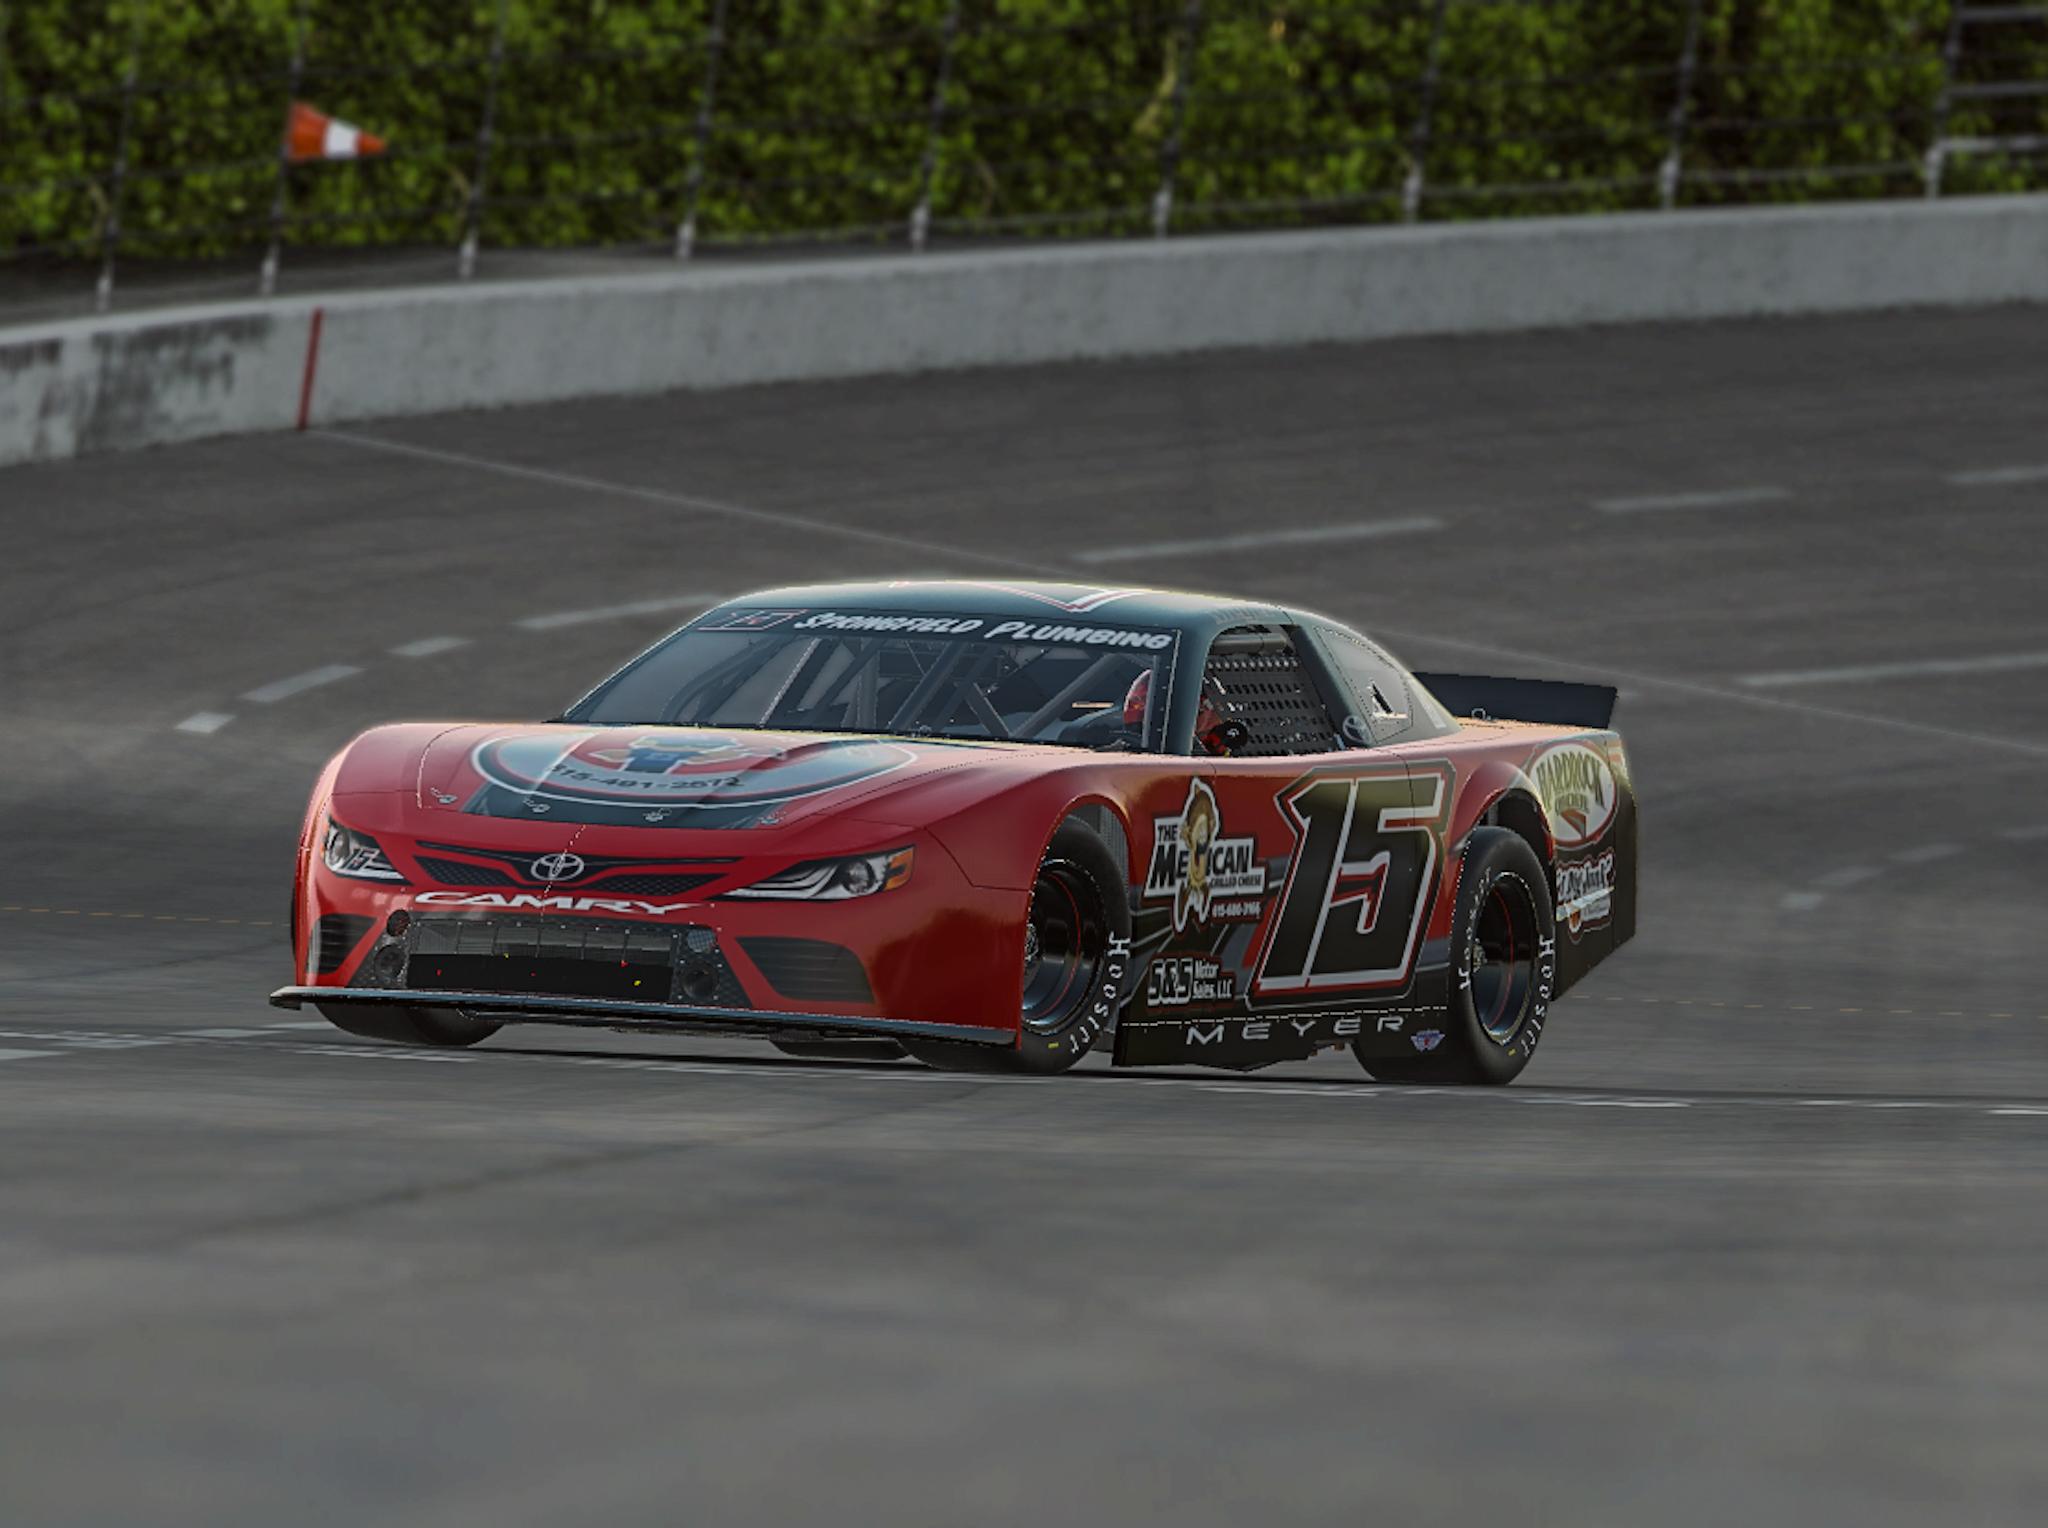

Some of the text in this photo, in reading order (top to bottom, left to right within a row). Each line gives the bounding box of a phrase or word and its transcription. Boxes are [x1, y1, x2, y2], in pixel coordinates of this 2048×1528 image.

[793, 612, 1173, 650] SPRINGFIELD PLUMBING
[1536, 751, 1608, 813] HARDROCK
[1157, 824, 1179, 842] THE
[1148, 843, 1251, 890] MEICAN
[1257, 766, 1450, 998] 15
[415, 891, 703, 915] CAMRY
[1186, 1016, 1405, 1045] MEYER
